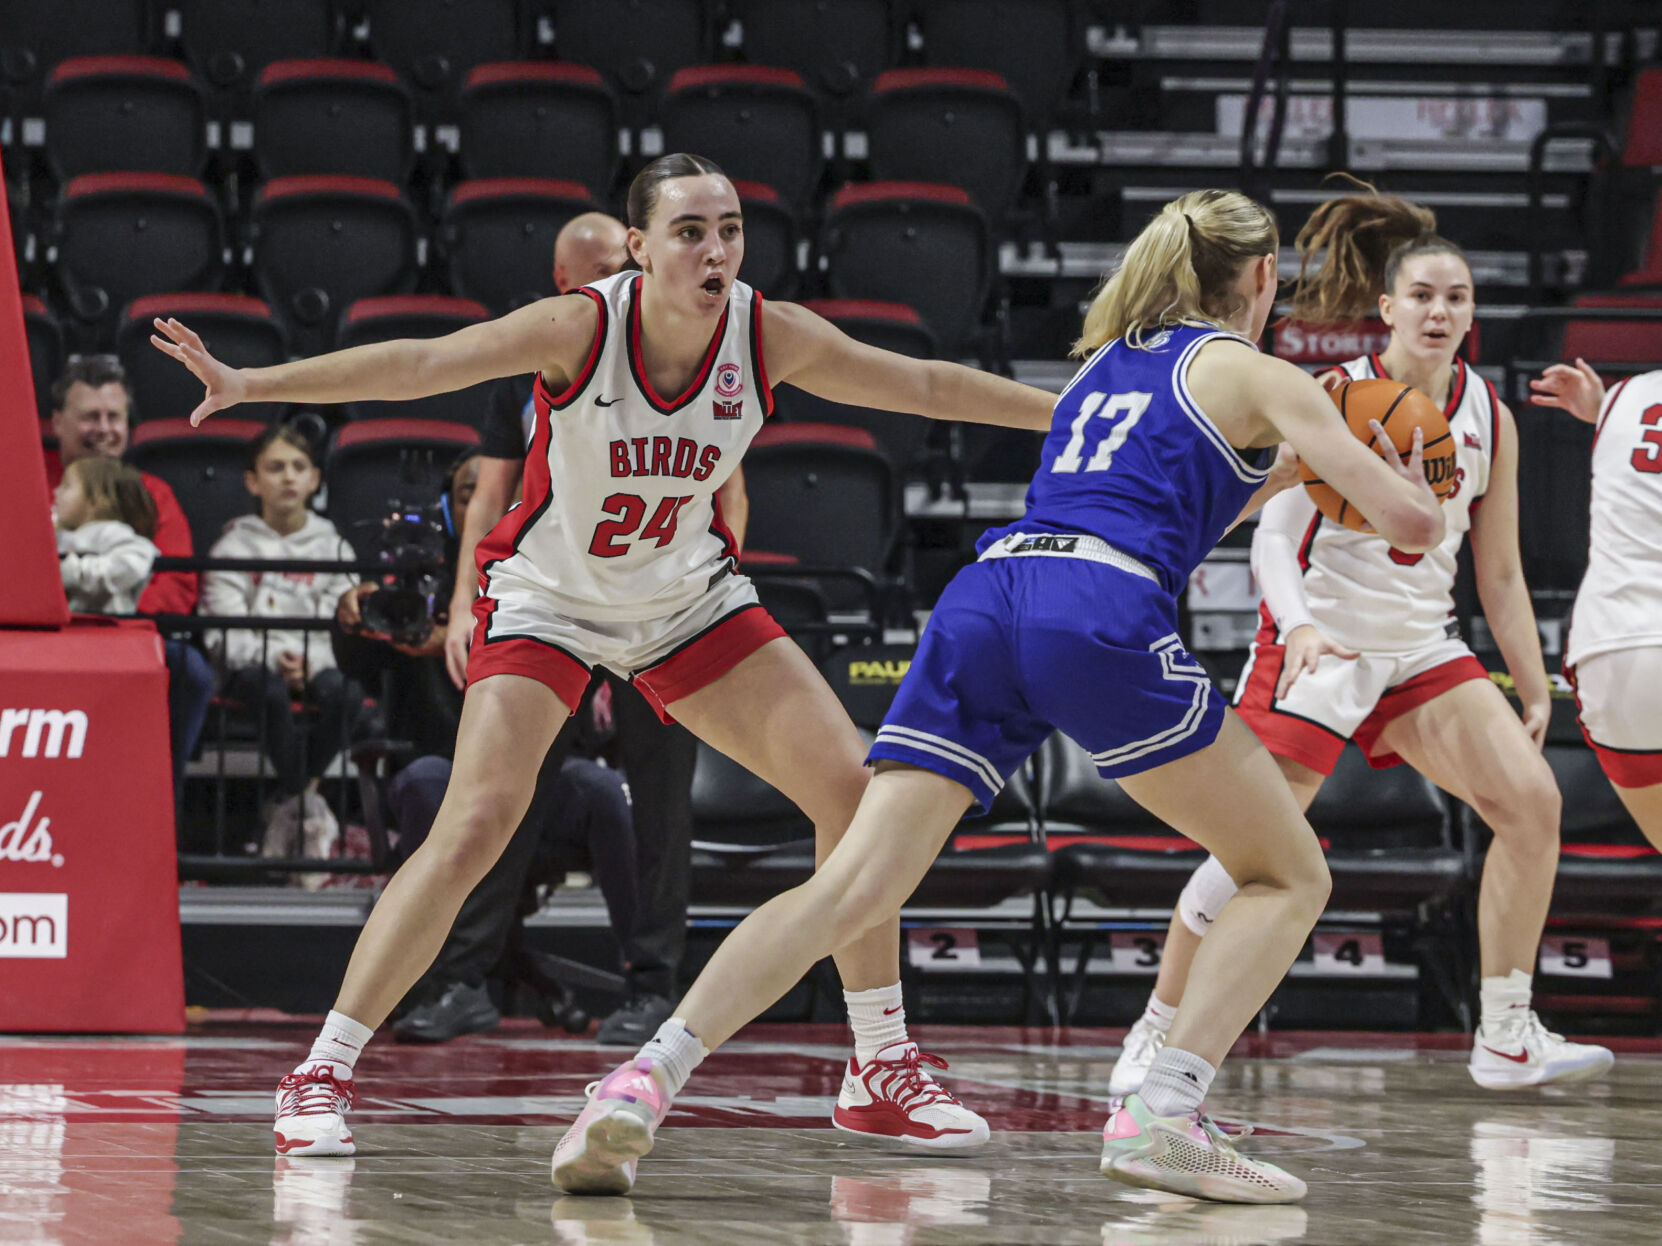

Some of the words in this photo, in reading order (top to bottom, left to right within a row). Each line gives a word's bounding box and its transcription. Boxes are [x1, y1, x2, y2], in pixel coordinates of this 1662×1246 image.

[1051, 391, 1153, 473] 17
[609, 435, 722, 482] BIRDS
[587, 492, 695, 559] 24
[848, 660, 912, 679] PAU
[929, 933, 959, 960] 2
[1132, 937, 1161, 967] 3
[1333, 939, 1365, 967] 4
[1562, 941, 1589, 969] 5
